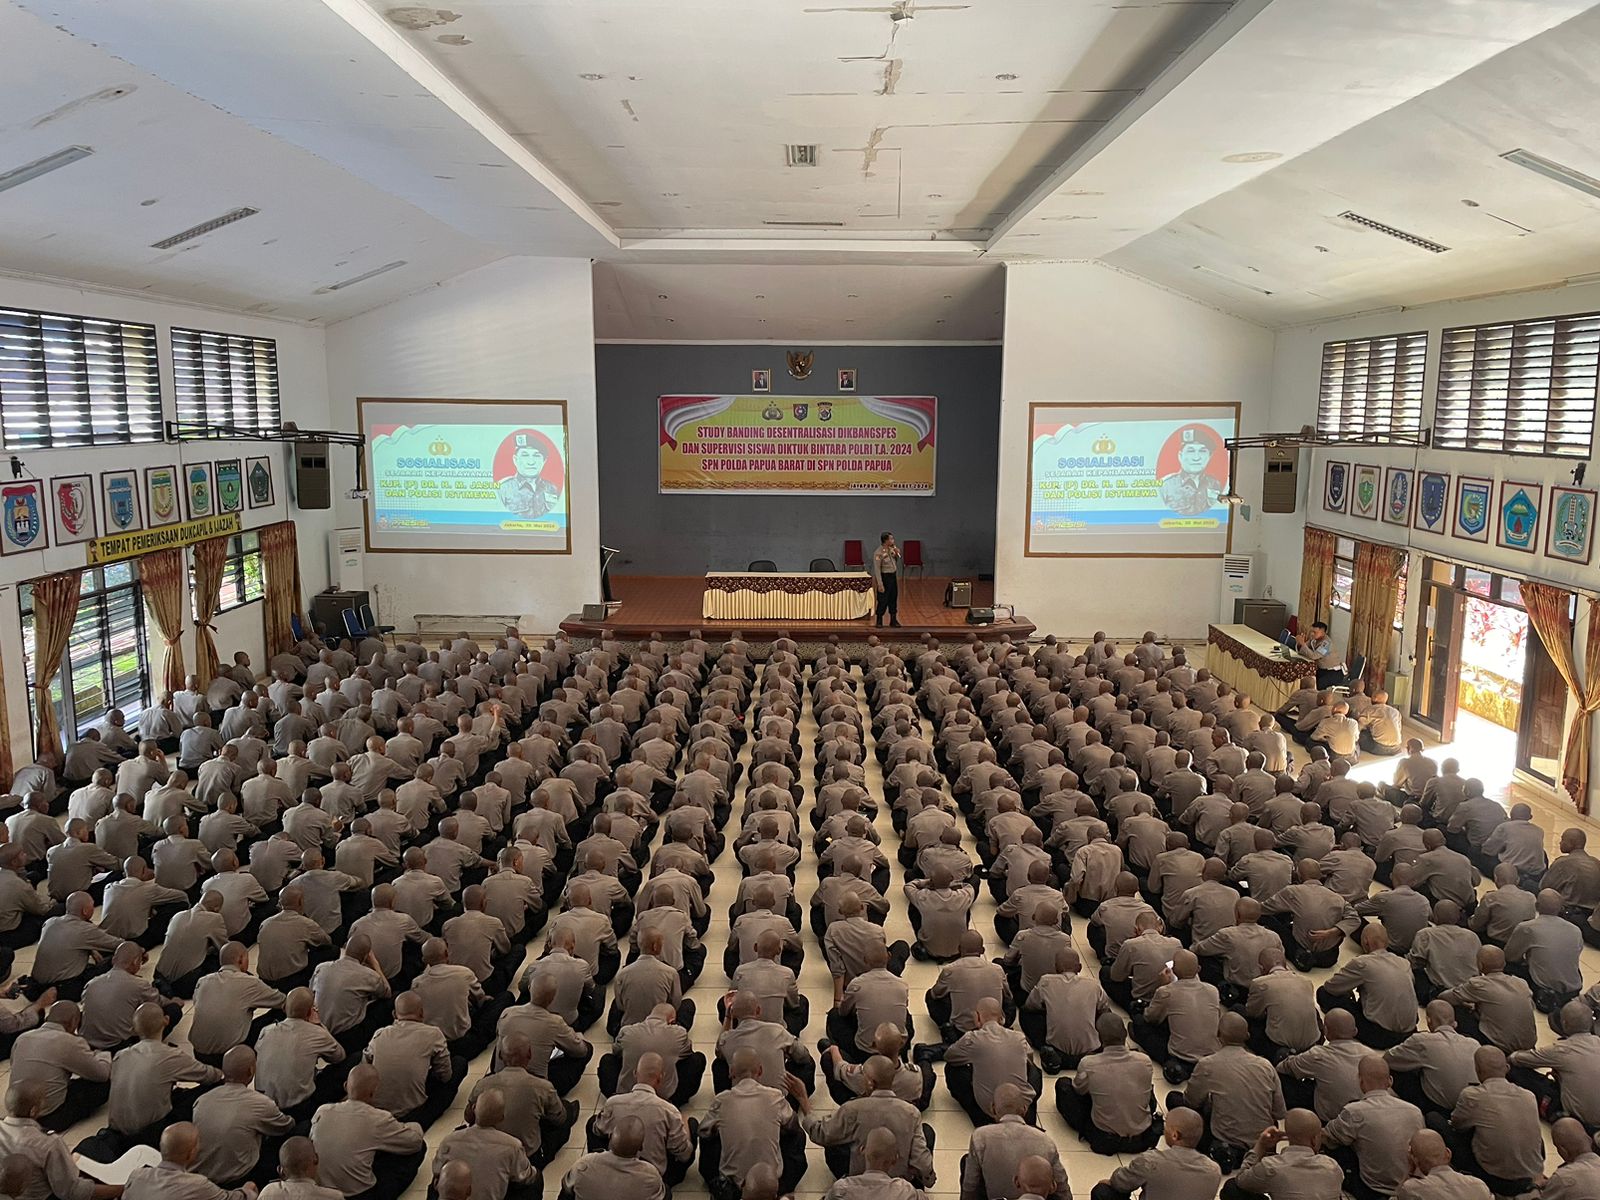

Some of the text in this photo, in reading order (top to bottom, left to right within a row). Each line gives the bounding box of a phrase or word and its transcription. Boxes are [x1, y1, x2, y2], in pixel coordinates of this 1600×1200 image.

[697, 427, 896, 439] STUDY BANDING DESENTRALISASI DIKBANGSPES
[682, 444, 912, 455] DAN SUPERVISI SISWA DIKTUK BINTARA POLRI T.A. 2024
[397, 458, 480, 468] SOSIALISASI
[702, 460, 892, 471] SPN POLDA PAPUA BARAT DI SPN POLDA PAPUA
[1058, 456, 1144, 469] SOSIALISASI
[470, 482, 501, 490] JASIN
[1081, 480, 1097, 489] DR.
[1116, 480, 1128, 488] M.
[1131, 479, 1163, 488] JASIN
[409, 490, 441, 498] POLISI
[445, 490, 496, 499] ISTIMEWA
[1043, 490, 1157, 499] DAN POLISI ISTIMEWA
[100, 517, 234, 557] TEMPAT PEMERIKSAAN DUKCAPIL & IJAZAH
